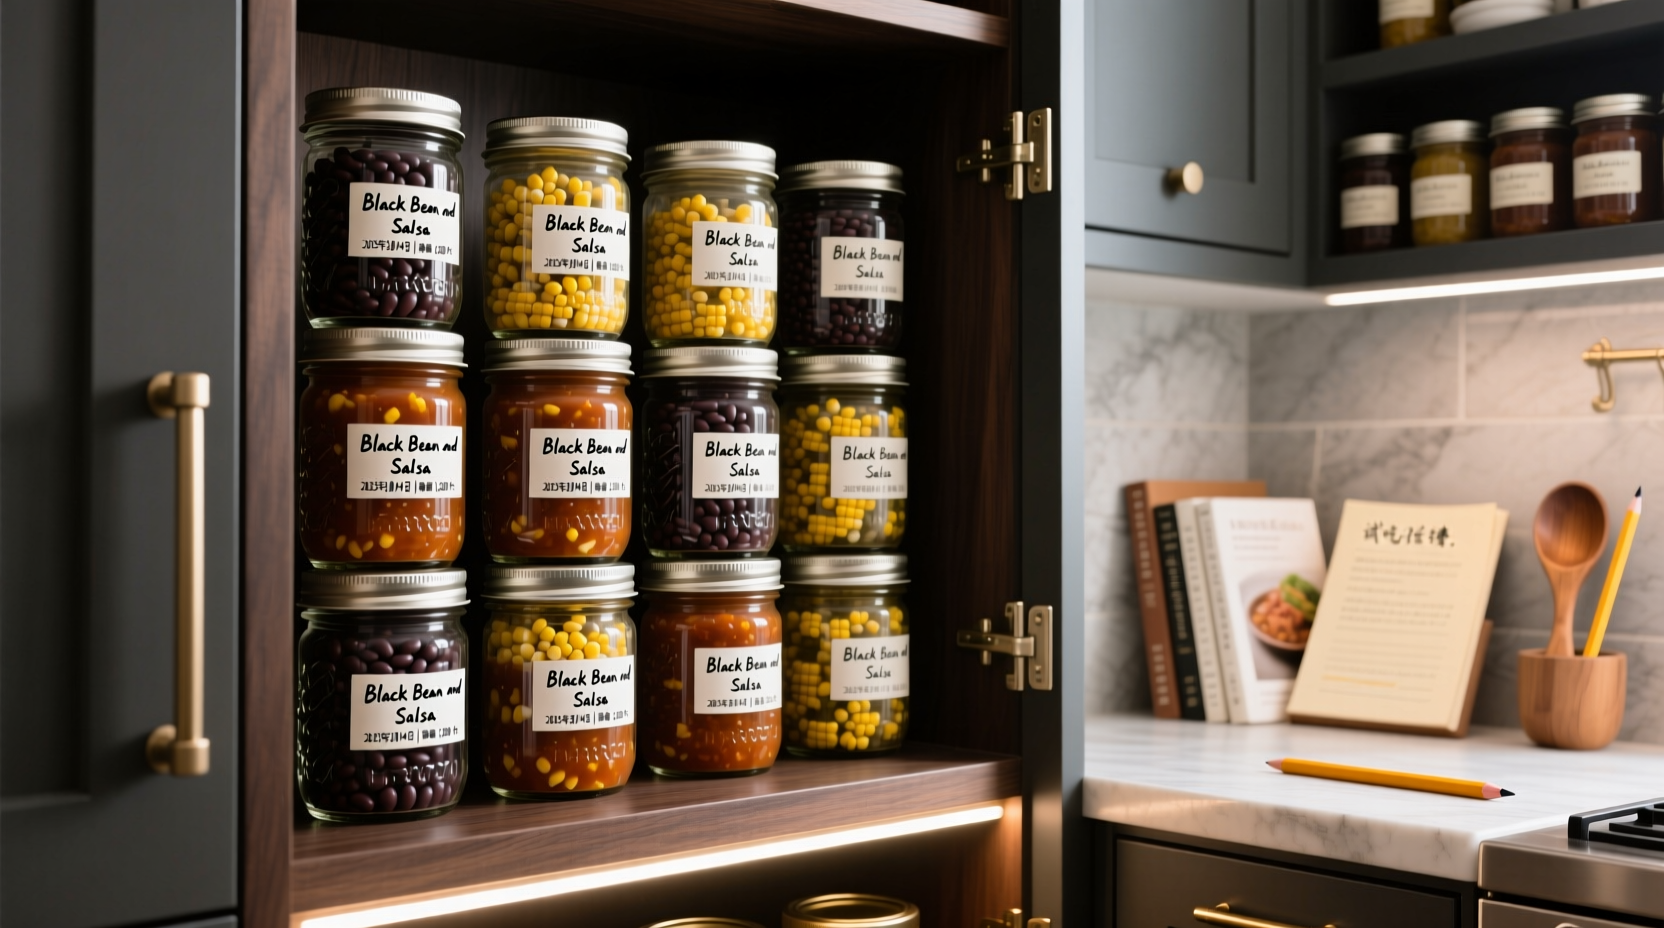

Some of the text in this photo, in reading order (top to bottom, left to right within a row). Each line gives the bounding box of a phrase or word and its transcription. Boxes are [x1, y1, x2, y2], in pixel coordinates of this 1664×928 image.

[362, 193, 406, 211] Black
[391, 218, 431, 235] Salsa
[545, 213, 585, 231] Black
[572, 237, 606, 254] Salsa
[705, 230, 740, 246] Black
[833, 244, 866, 260] Black
[360, 433, 404, 452] Black
[408, 435, 439, 452] Bean
[542, 437, 583, 455] Black
[705, 441, 742, 457] Black
[843, 446, 876, 460] Black
[390, 458, 431, 474] Salsa
[569, 460, 606, 476] Salsa
[729, 462, 760, 477] Salsa
[843, 646, 876, 662] Black
[706, 656, 742, 674] Black
[546, 670, 587, 688] Black
[591, 669, 617, 685] Bean
[730, 677, 761, 692] Salsa
[364, 678, 462, 704] Black Bean and
[573, 691, 609, 708] Salsa
[395, 706, 437, 725] Salsa
